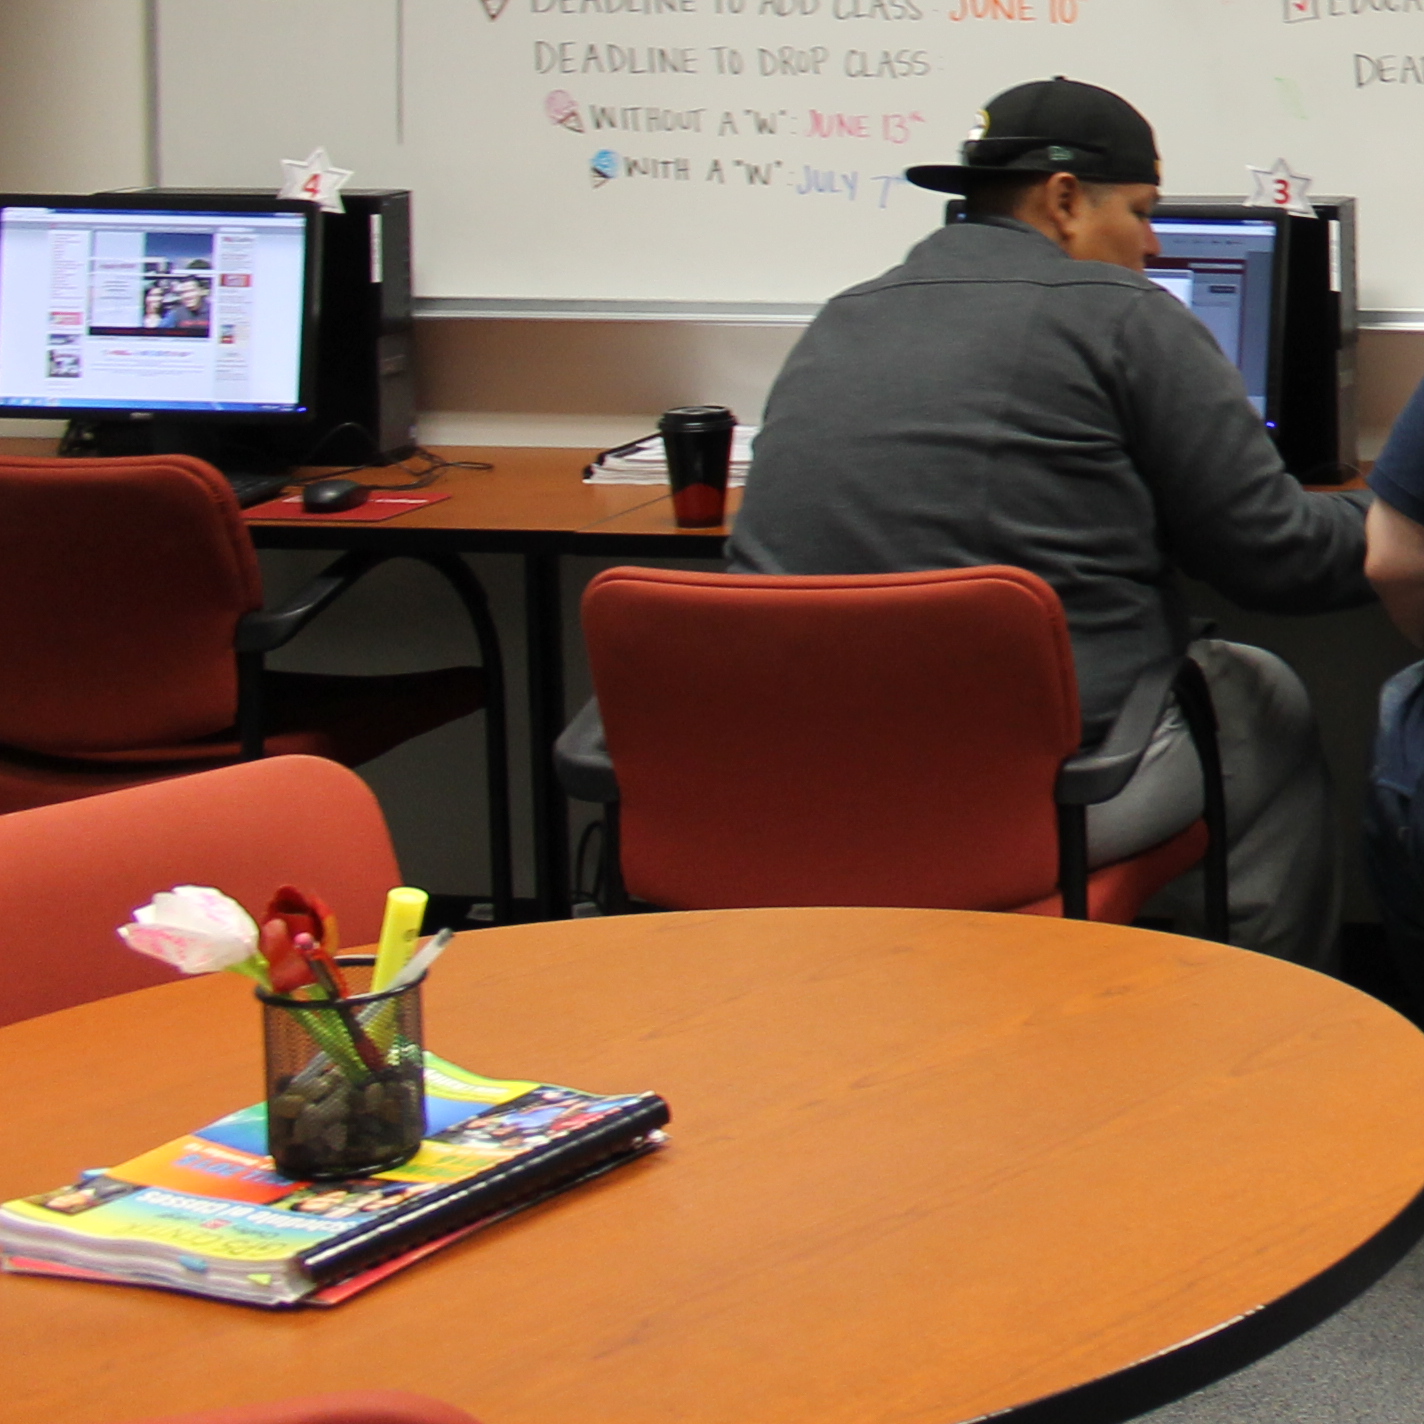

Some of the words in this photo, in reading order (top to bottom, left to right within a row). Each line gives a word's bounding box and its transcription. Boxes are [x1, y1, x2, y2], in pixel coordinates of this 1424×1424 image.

[535, 41, 699, 75] DEADLINE
[708, 46, 744, 76] TO
[758, 46, 829, 76] DROP
[590, 105, 708, 133] WITHOUT
[718, 110, 739, 137] A
[805, 108, 872, 139] JUNE
[302, 173, 322, 197] 4
[623, 156, 692, 181] WITH
[705, 159, 726, 184] A
[797, 165, 859, 201] JULY
[1272, 178, 1292, 204] 3
